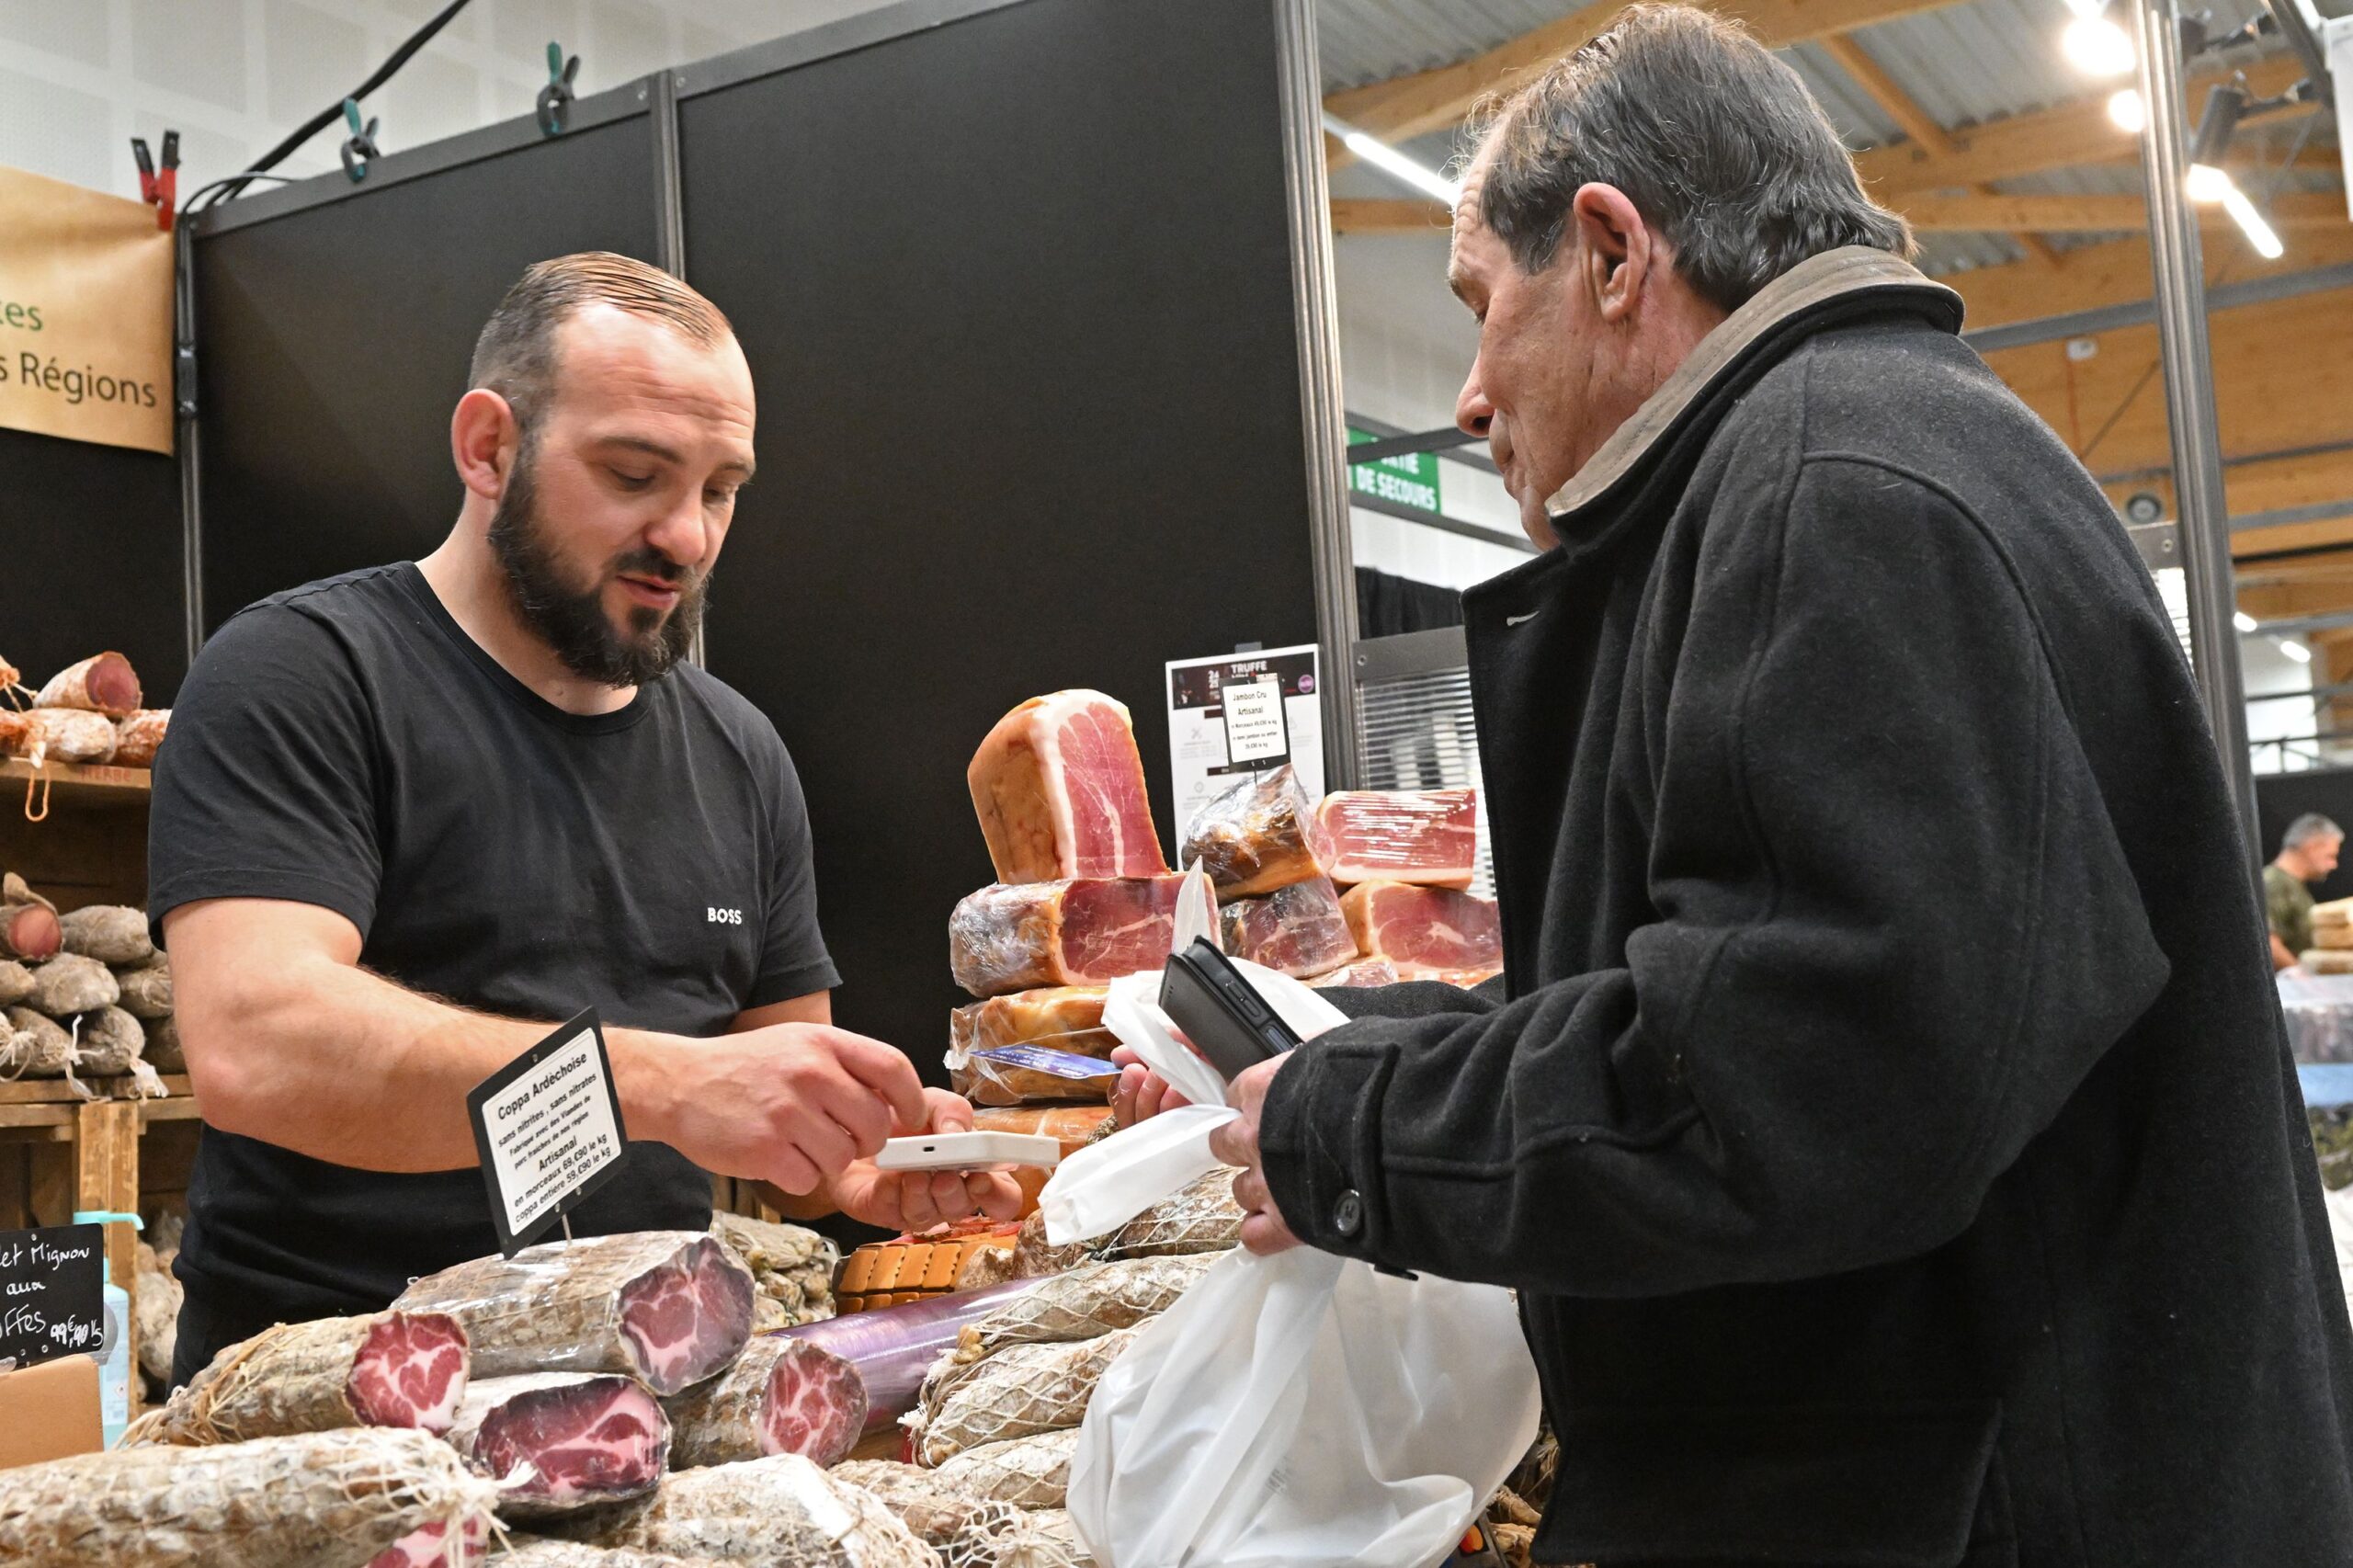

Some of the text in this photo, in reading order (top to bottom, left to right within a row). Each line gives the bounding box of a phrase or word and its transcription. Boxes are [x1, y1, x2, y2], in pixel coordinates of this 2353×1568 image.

[19, 350, 157, 408] Régions
[1355, 464, 1437, 511] DE SECOURS
[1231, 660, 1267, 674] TRUFFE
[1233, 690, 1267, 701] Jambon Cru
[1238, 705, 1264, 715] Artisanal
[707, 906, 743, 926] BOSS
[498, 1053, 587, 1120] Coppa Ardèchoise
[498, 1131, 516, 1147] sans
[517, 1109, 545, 1133] nitrites
[550, 1093, 568, 1110] sans
[568, 1073, 597, 1097] nitrates
[535, 1125, 550, 1139] avec
[539, 1135, 577, 1172] Artisanal
[514, 1196, 525, 1208] en
[525, 1166, 562, 1199] morceaux
[588, 1141, 597, 1152] le
[597, 1132, 608, 1145] kg
[515, 1201, 539, 1223] coppa
[592, 1154, 600, 1165] le
[600, 1145, 611, 1159] kg
[0, 1243, 23, 1267] et
[6, 1281, 46, 1296] aux
